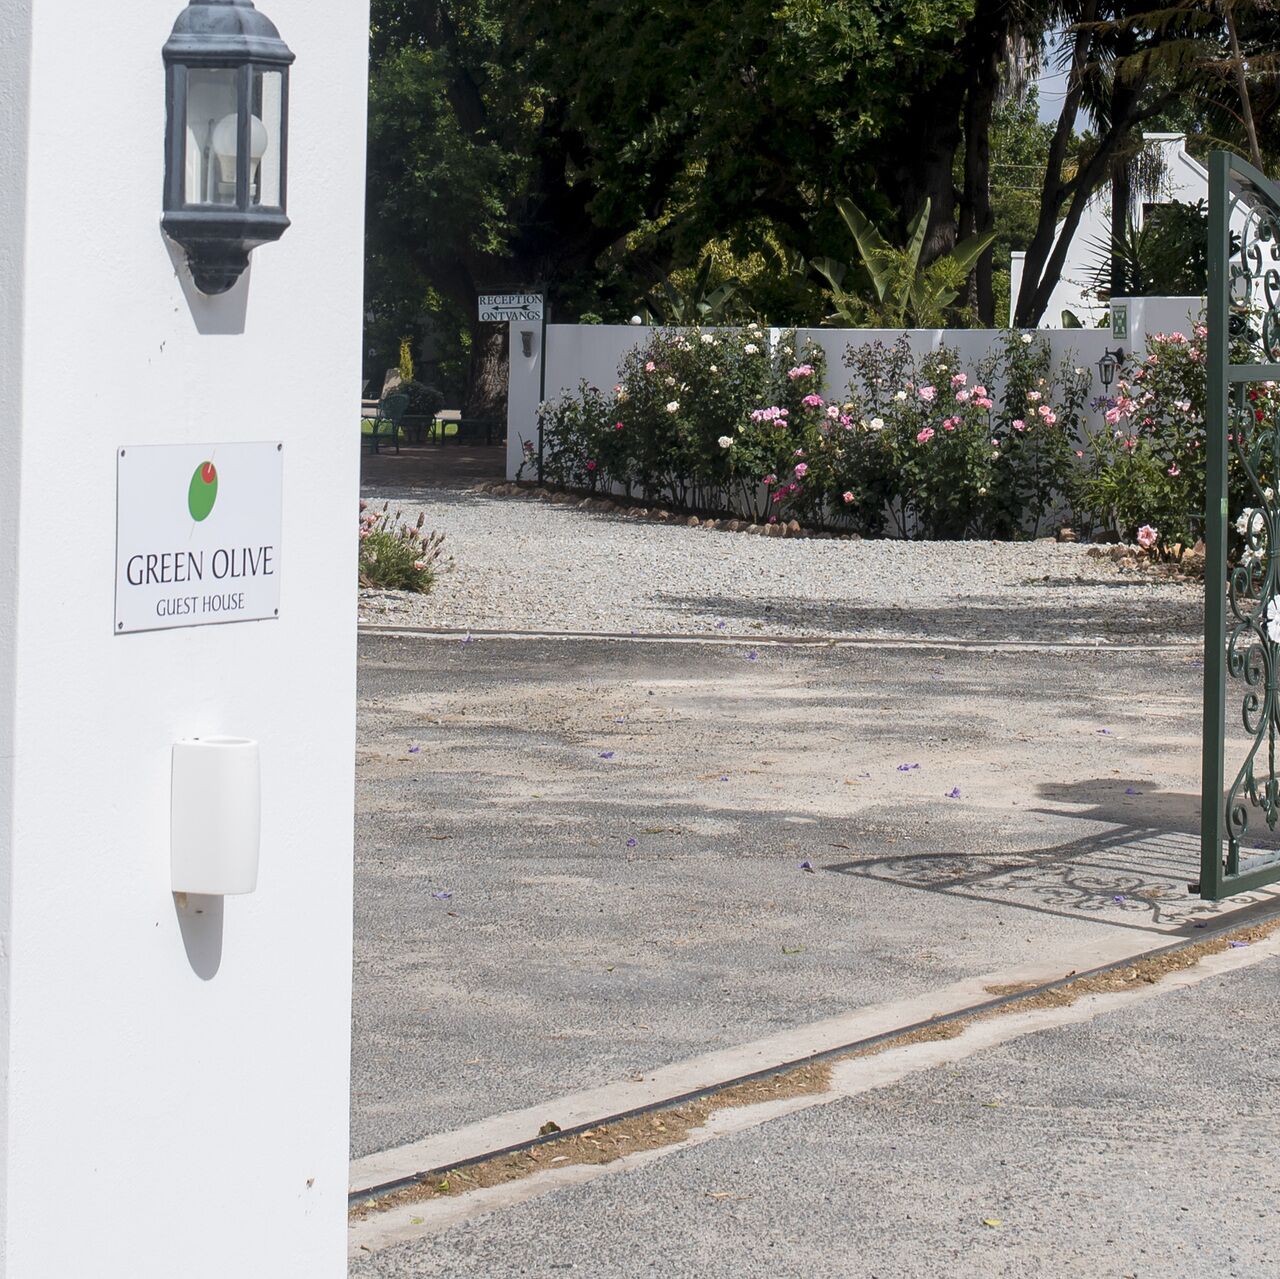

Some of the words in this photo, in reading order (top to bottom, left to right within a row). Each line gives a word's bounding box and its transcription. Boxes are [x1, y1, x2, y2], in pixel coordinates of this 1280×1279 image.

[480, 295, 543, 305] RECEPTION
[482, 311, 540, 320] ONTVANGS
[126, 550, 204, 586] GREEN
[212, 546, 274, 580] OLIVE
[156, 596, 199, 616] GUEST
[202, 592, 245, 612] HOUSE
